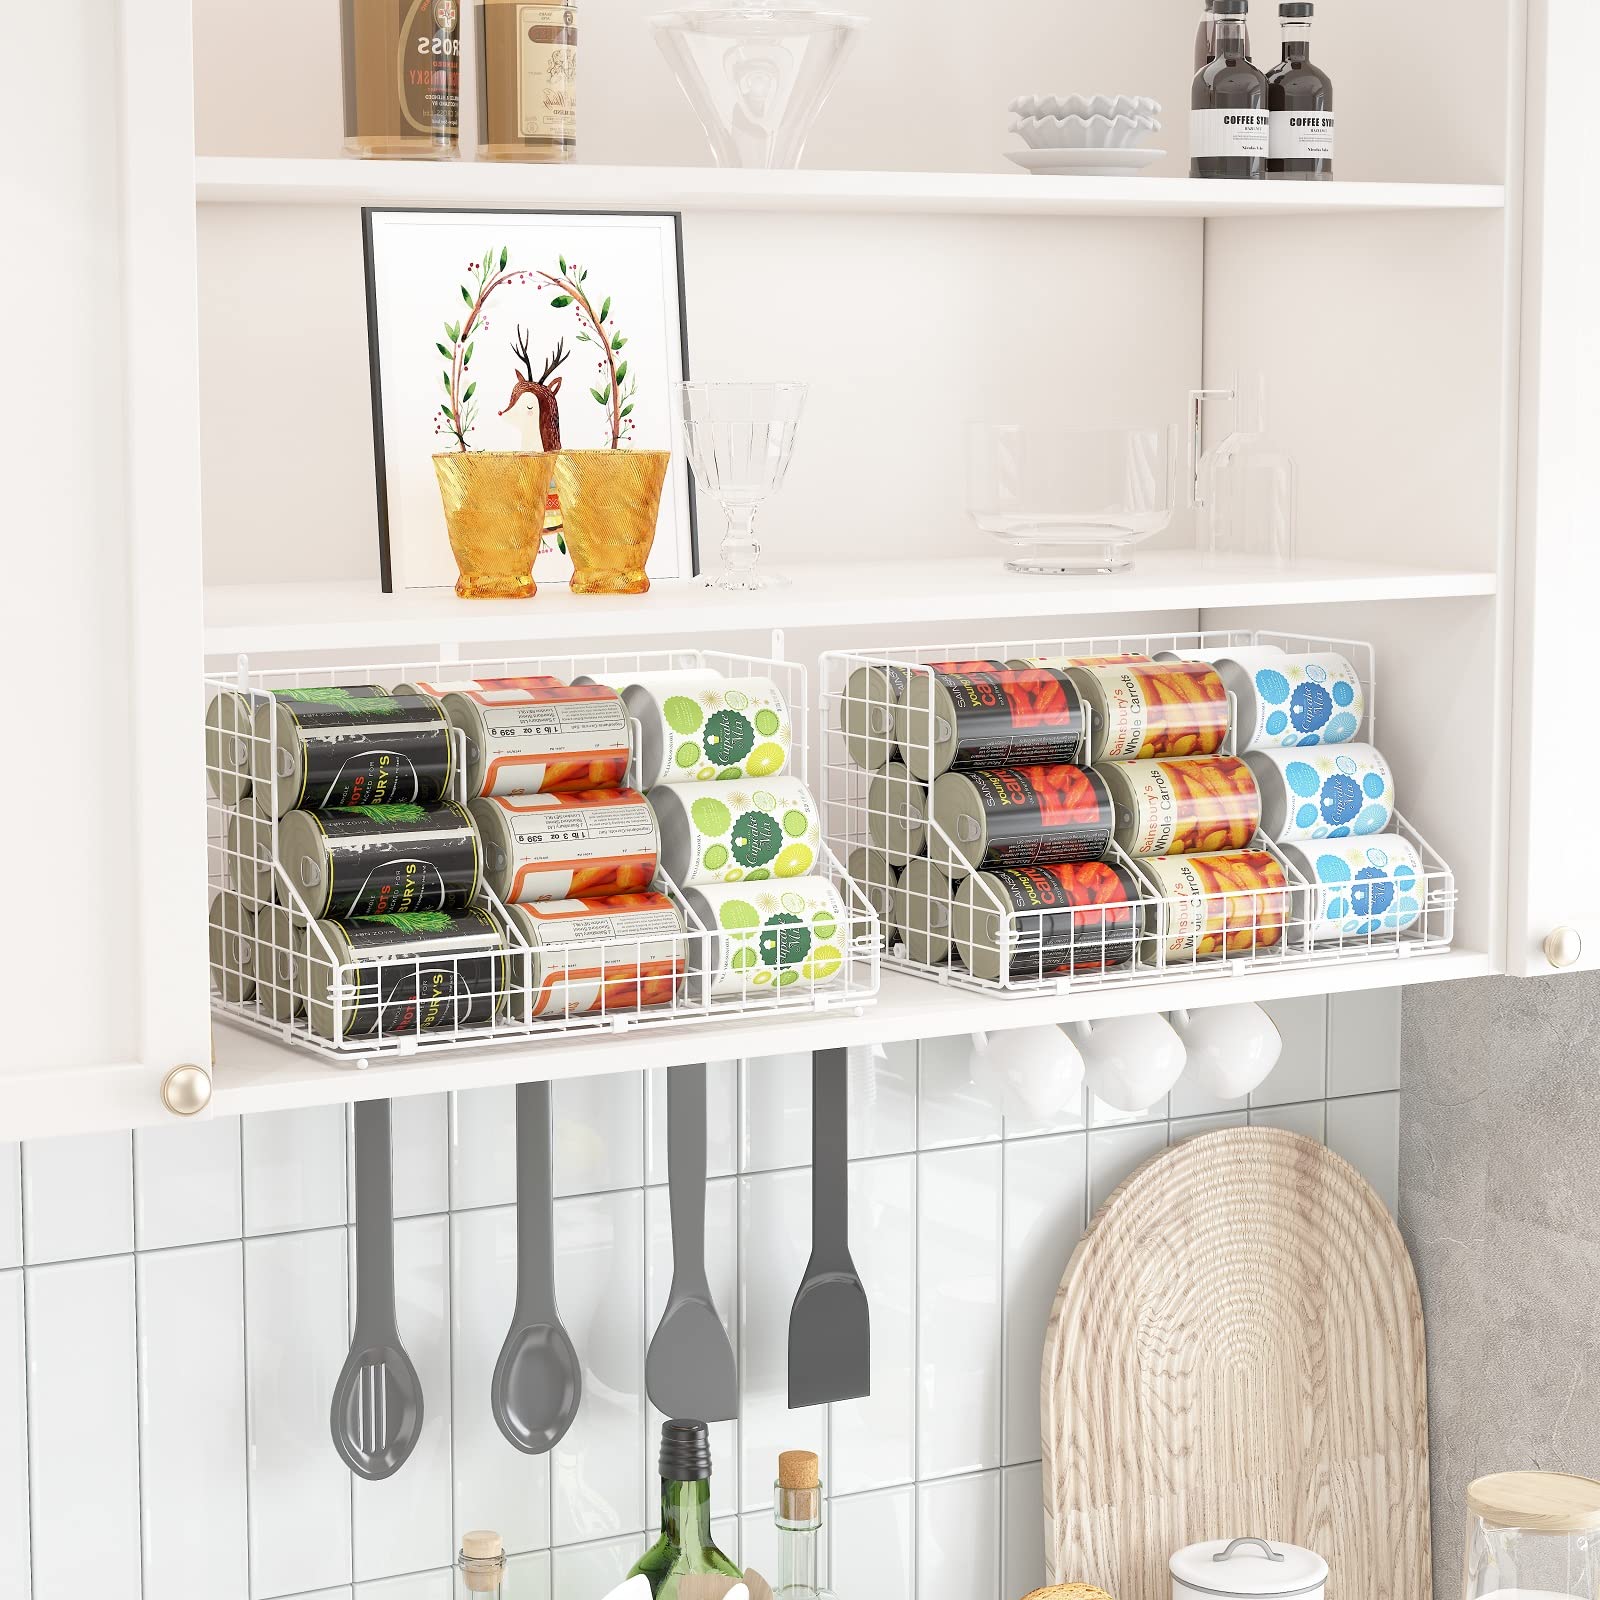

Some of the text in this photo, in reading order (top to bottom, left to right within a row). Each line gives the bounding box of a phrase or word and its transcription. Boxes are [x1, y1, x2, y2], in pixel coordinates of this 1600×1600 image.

[1223, 115, 1255, 125] COFFEE
[1289, 117, 1320, 127] COFFEE
[1109, 688, 1128, 756] Sainsbury's
[1121, 674, 1142, 755] Whole Carrots
[1302, 685, 1314, 730] Cupcake
[718, 714, 733, 762] Cupcake
[732, 719, 744, 749] Mix
[371, 755, 390, 805] BURY'S
[988, 777, 1012, 806] young
[1331, 778, 1345, 823] Cupcake
[1344, 782, 1355, 810] Mix
[1139, 784, 1158, 853] Sainsbury's
[1151, 770, 1172, 852] Whole Carrots
[746, 815, 761, 865] Cupcake
[760, 822, 773, 851] Mix
[397, 863, 417, 913] BURY'S
[1019, 876, 1042, 906] young
